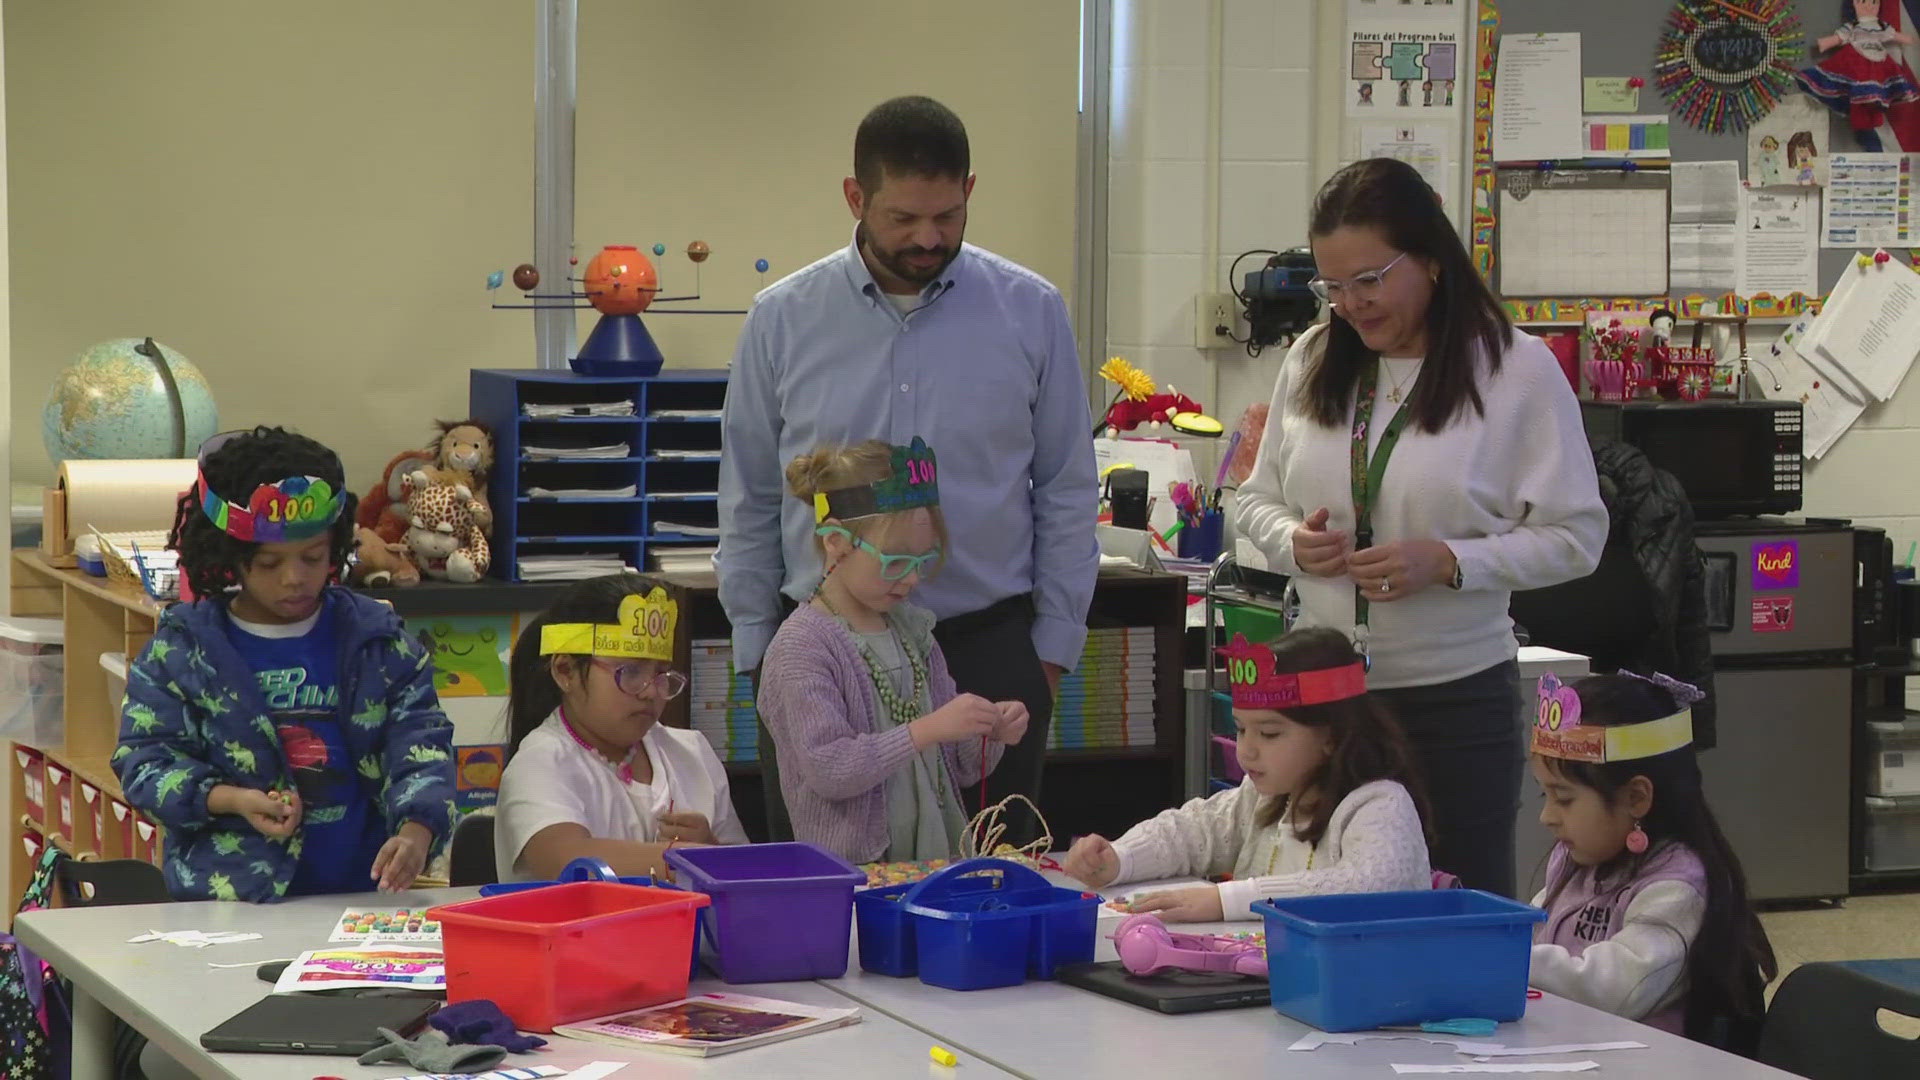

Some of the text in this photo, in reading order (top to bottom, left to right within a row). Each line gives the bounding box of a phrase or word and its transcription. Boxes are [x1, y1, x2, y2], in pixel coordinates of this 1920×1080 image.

[1353, 32, 1380, 40] Pilares
[1383, 32, 1395, 40] del
[1398, 33, 1436, 43] Programa
[906, 459, 936, 484] 100
[268, 496, 315, 522] 100
[1758, 551, 1791, 571] Kind
[632, 607, 670, 640] 100
[1228, 656, 1257, 685] 100
